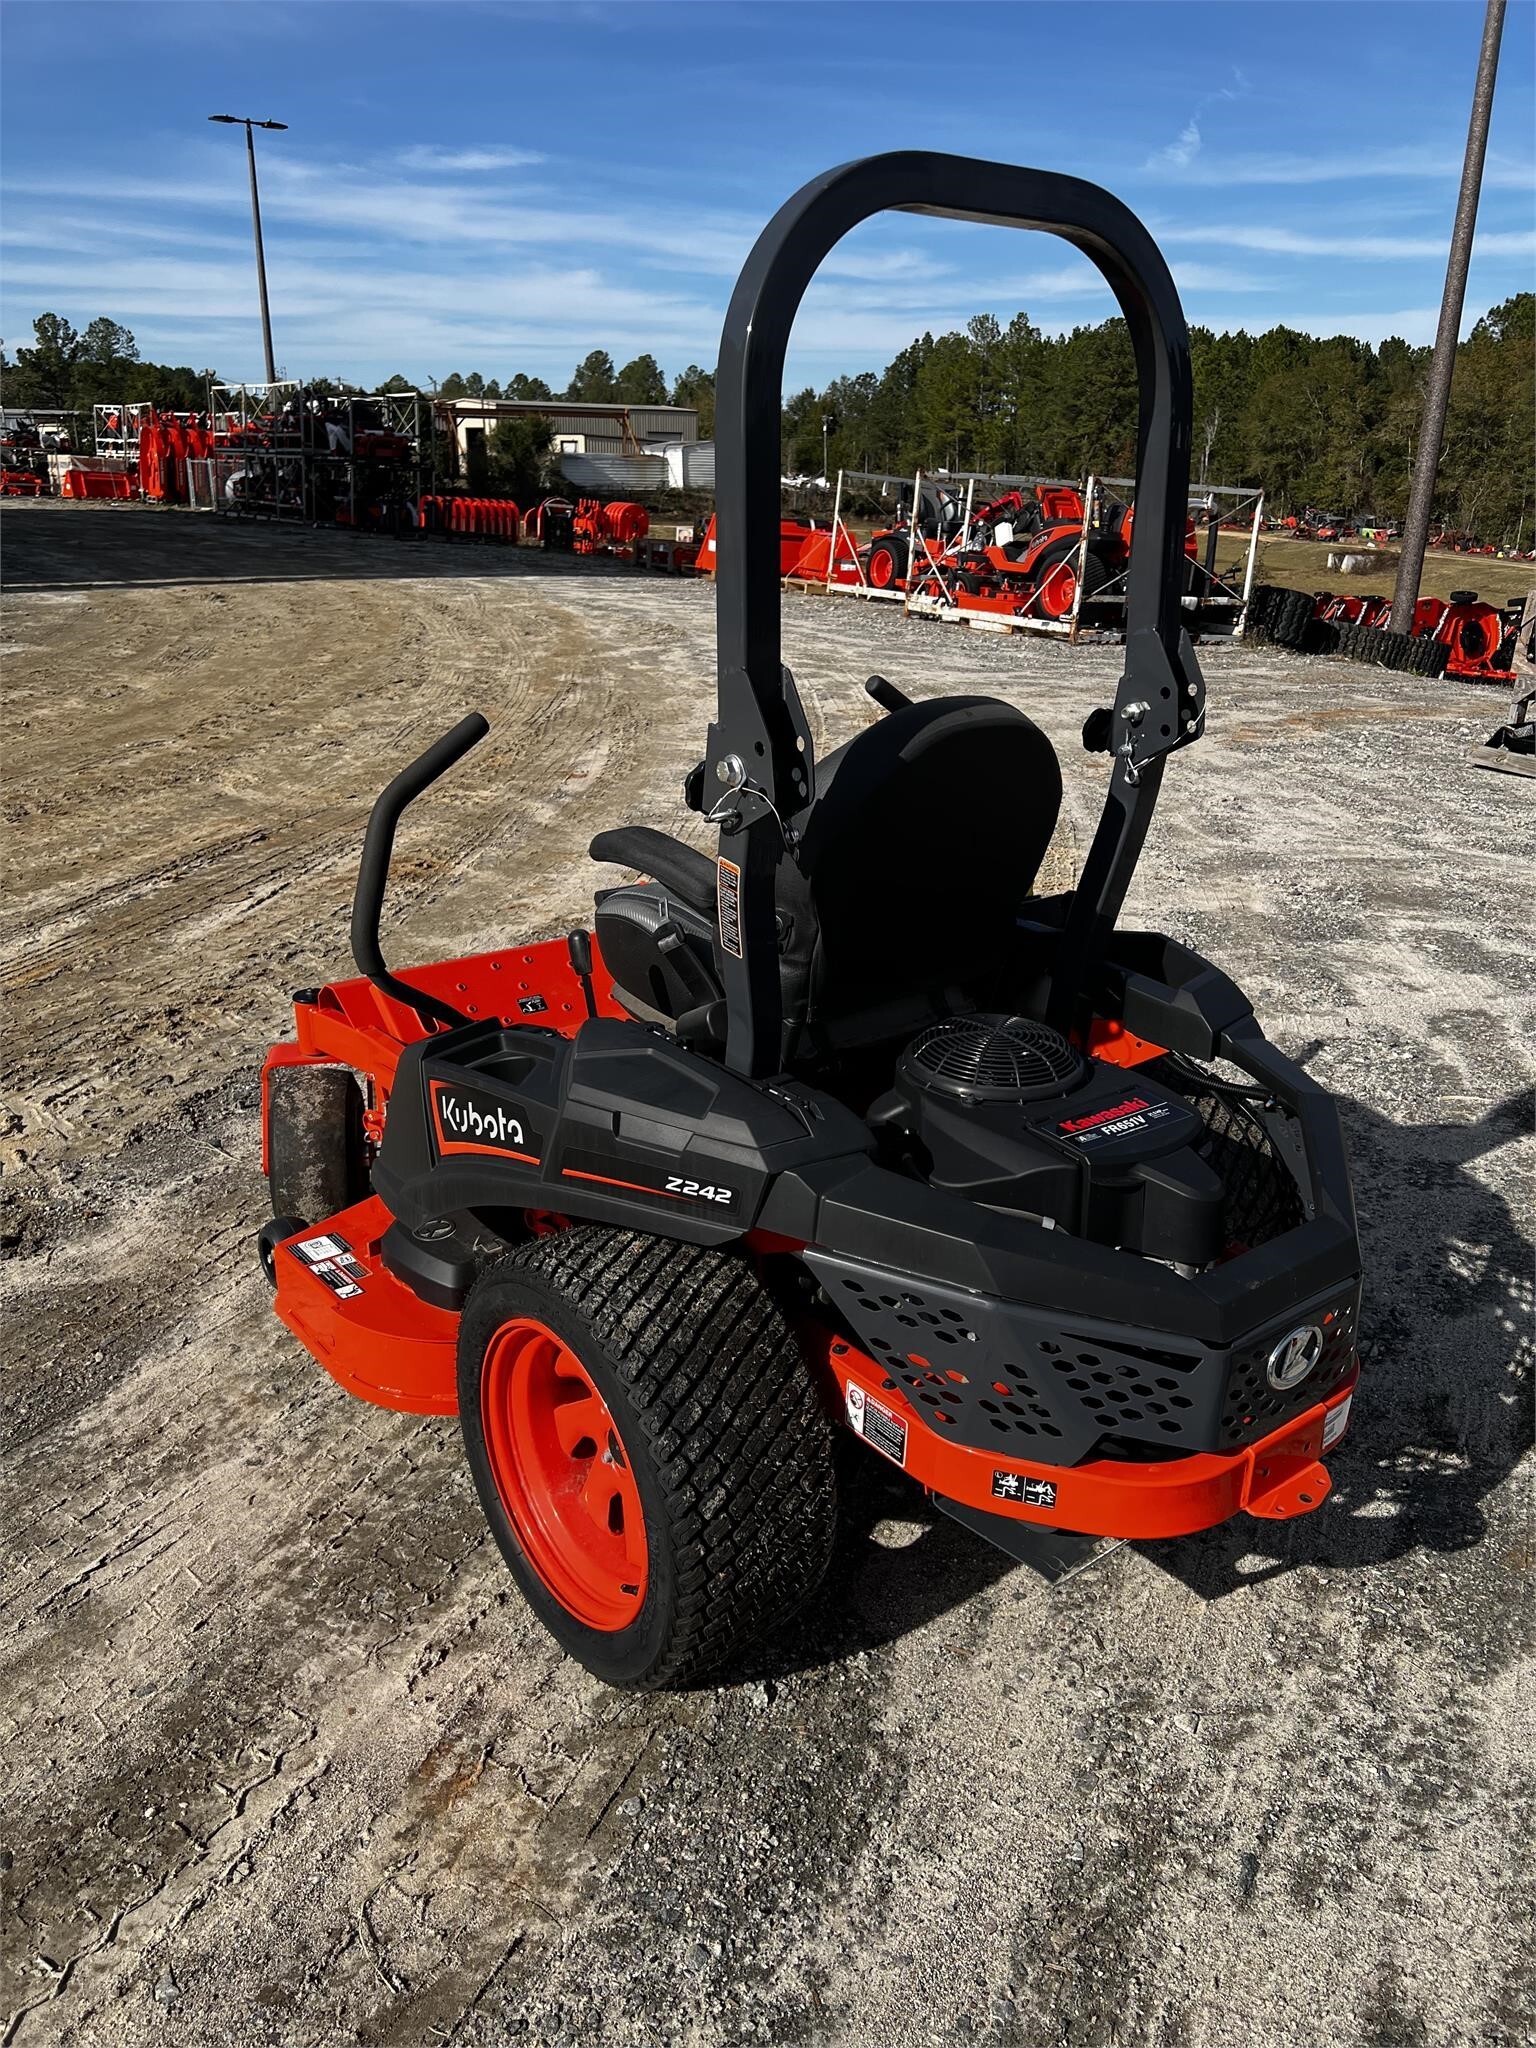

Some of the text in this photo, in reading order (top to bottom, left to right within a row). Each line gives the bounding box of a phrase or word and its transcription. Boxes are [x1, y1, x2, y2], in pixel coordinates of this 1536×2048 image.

[441, 1095, 524, 1145] Kubota
[1058, 1097, 1150, 1132] Kawasaki
[1101, 1114, 1146, 1136] FR651V
[664, 1176, 732, 1204] Z242
[870, 1398, 893, 1419] DANGER
